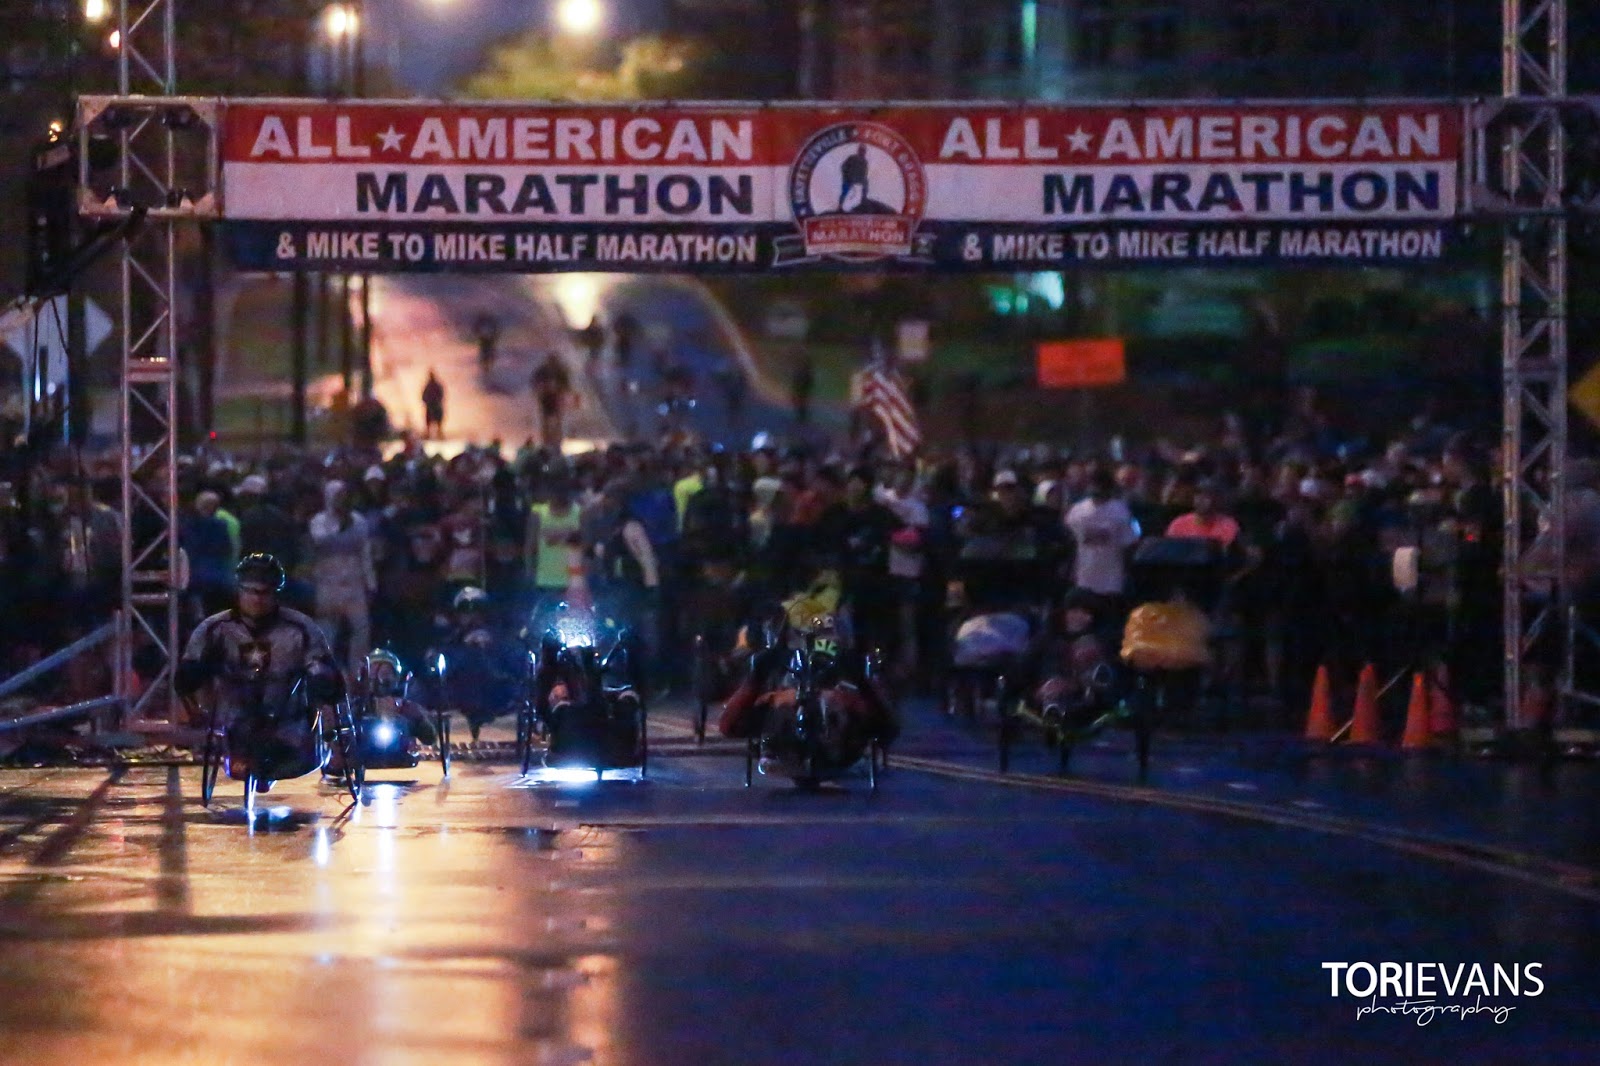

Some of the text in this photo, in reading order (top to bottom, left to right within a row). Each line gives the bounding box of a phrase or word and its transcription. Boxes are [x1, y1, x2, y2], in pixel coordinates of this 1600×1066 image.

[250, 115, 753, 161] ALL AMERICAN
[939, 114, 1440, 159] ALL AMERICAN
[356, 171, 753, 215] MARATHON
[1043, 170, 1440, 214] MARATHON
[276, 231, 758, 262] & MIKE TO MIKE HALF MARATHON
[963, 229, 1442, 261] & MIKE TO MIKE HALF MARATHON
